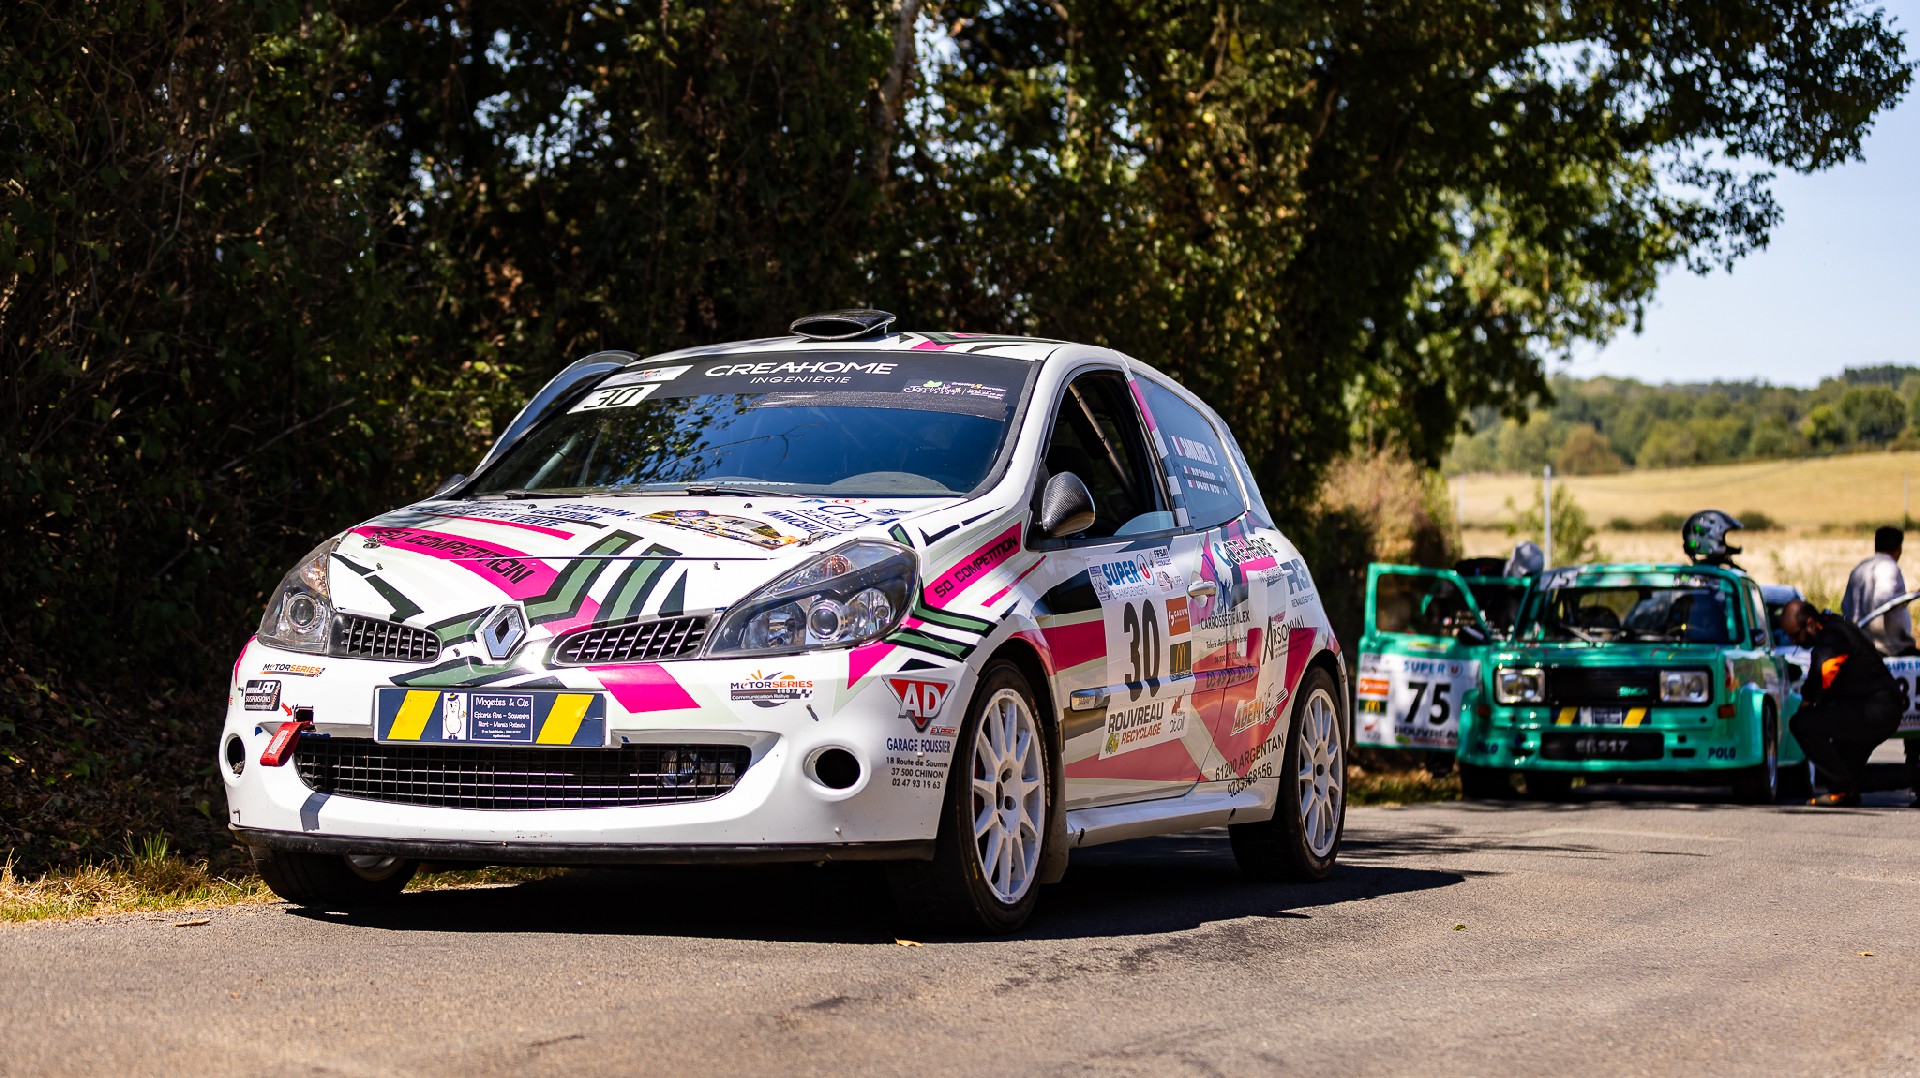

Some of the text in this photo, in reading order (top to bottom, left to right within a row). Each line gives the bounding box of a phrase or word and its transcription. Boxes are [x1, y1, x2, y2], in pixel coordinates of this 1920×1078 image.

[704, 361, 898, 377] CREAHOME
[750, 376, 851, 384] INGENIERIE
[584, 387, 646, 409] 30
[404, 533, 536, 585] COMPETITION
[954, 535, 1020, 583] COMPETITION
[1102, 560, 1142, 586] SUPER
[1123, 599, 1161, 702] 30
[1404, 661, 1445, 675] SUPER
[517, 698, 530, 707] Cie
[899, 682, 942, 718] AD
[1404, 681, 1452, 726] 75
[1107, 702, 1165, 734] ROUVREAU
[930, 726, 957, 736] EXPERT
[1121, 722, 1162, 745] RECYCLAGE
[886, 737, 951, 754] GARAGE FOUSSIER
[1708, 747, 1736, 759] POLO
[886, 756, 894, 765] 18
[896, 758, 916, 767] Route
[916, 759, 925, 767] de
[1215, 733, 1285, 780] 61200 ARGENTAN
[892, 779, 901, 787] 02
[901, 779, 910, 788] 47
[914, 769, 944, 779] CHINON
